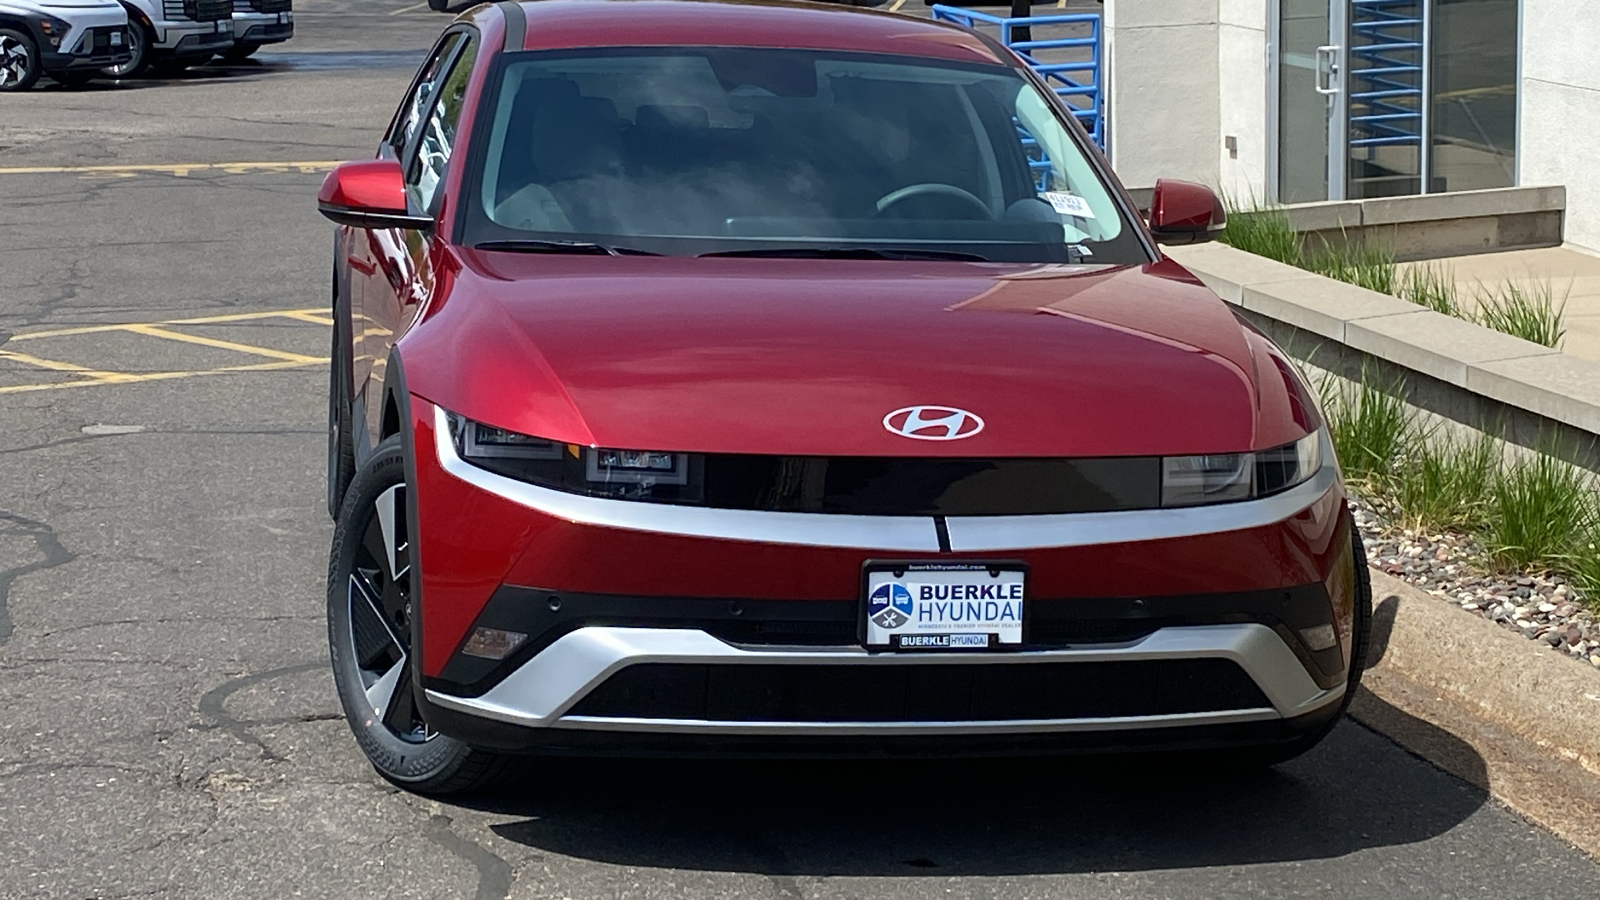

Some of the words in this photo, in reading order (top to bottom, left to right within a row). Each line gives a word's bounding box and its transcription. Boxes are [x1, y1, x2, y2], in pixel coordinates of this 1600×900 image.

[920, 585, 1022, 600] BUERKLE
[919, 601, 1022, 622] HYUNDAI
[901, 636, 949, 646] BUERKLE
[951, 636, 987, 646] HYUNDAI
